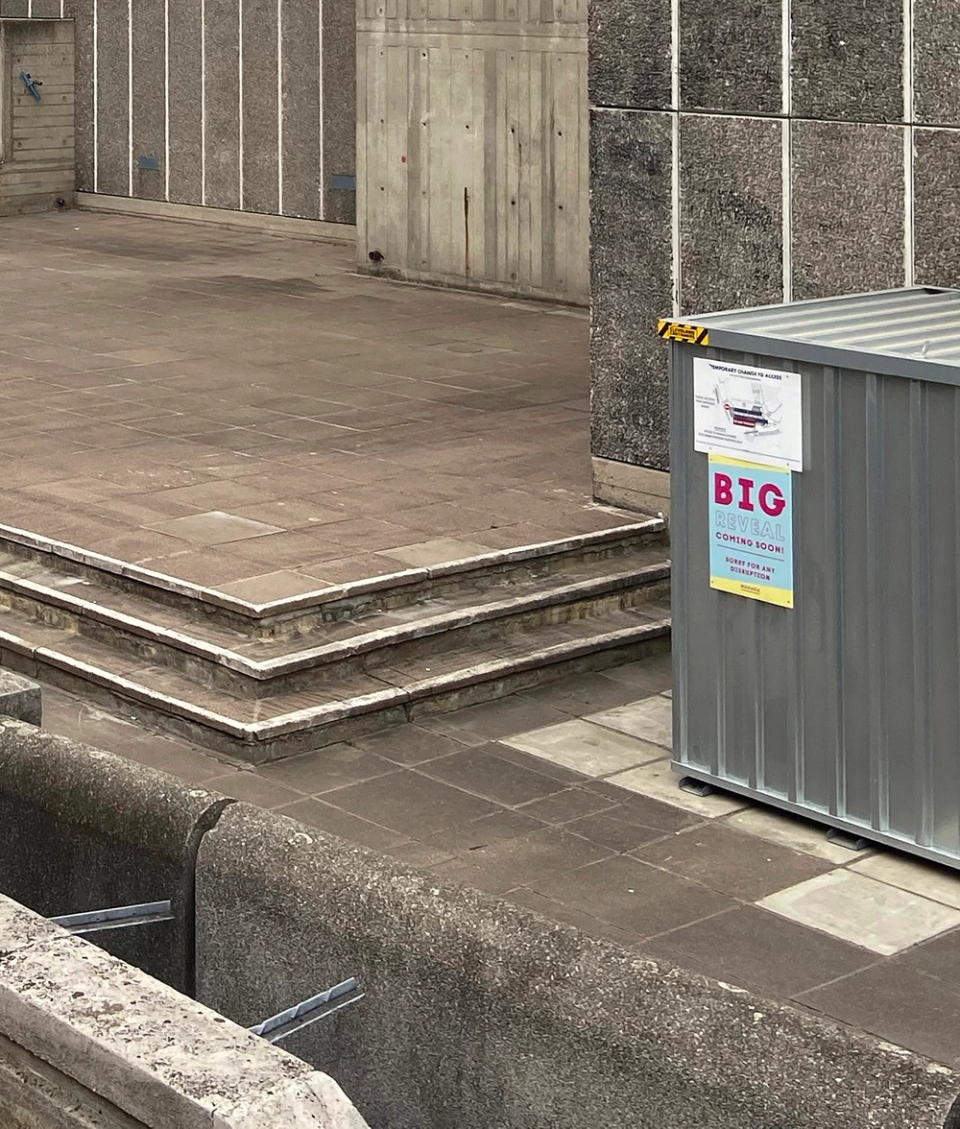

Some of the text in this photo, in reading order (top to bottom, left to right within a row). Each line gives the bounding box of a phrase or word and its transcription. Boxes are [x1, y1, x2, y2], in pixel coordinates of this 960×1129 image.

[714, 472, 786, 517] BIG
[715, 510, 786, 542] REVEAL
[715, 531, 785, 554] COMING SOON!
[725, 556, 775, 574] SORRY FOR ANY
[730, 566, 771, 581] DISRUPTION
